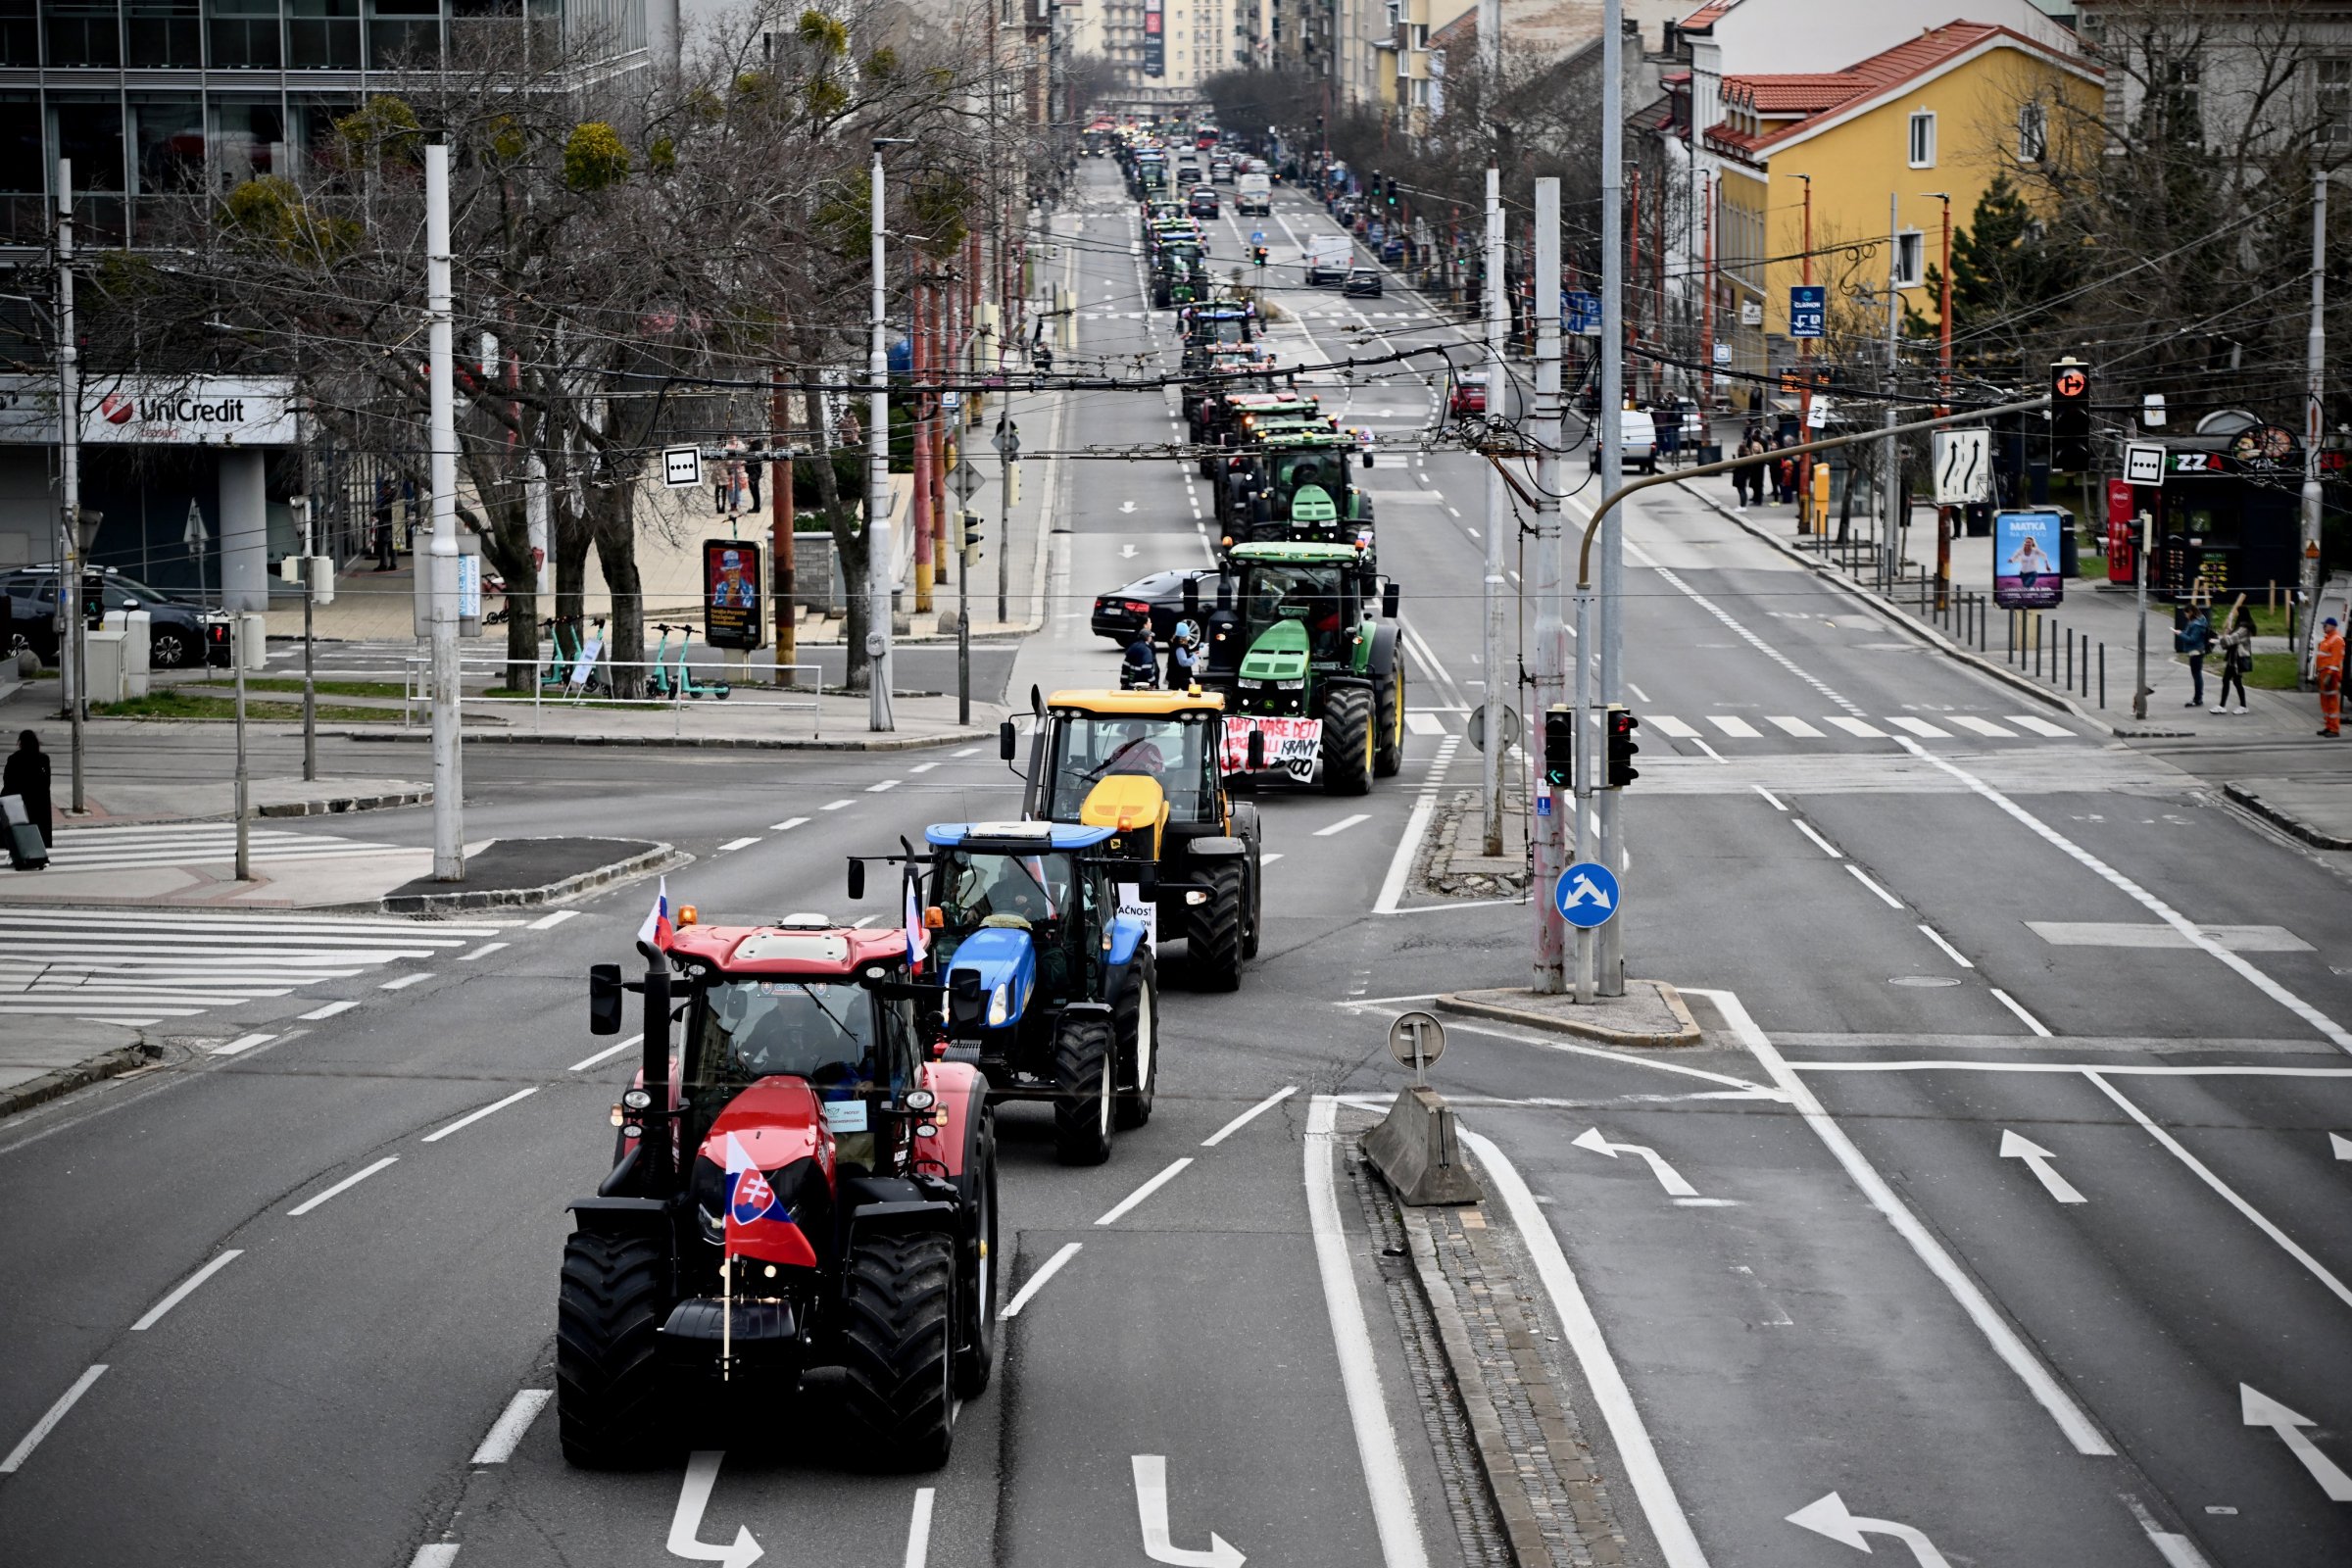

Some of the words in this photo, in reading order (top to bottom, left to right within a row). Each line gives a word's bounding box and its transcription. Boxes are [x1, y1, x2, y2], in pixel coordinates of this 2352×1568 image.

[140, 398, 244, 422] UniCredit
[2009, 521, 2047, 531] MATKA
[1228, 716, 1251, 733] ABY
[1281, 740, 1318, 757] KRAVY
